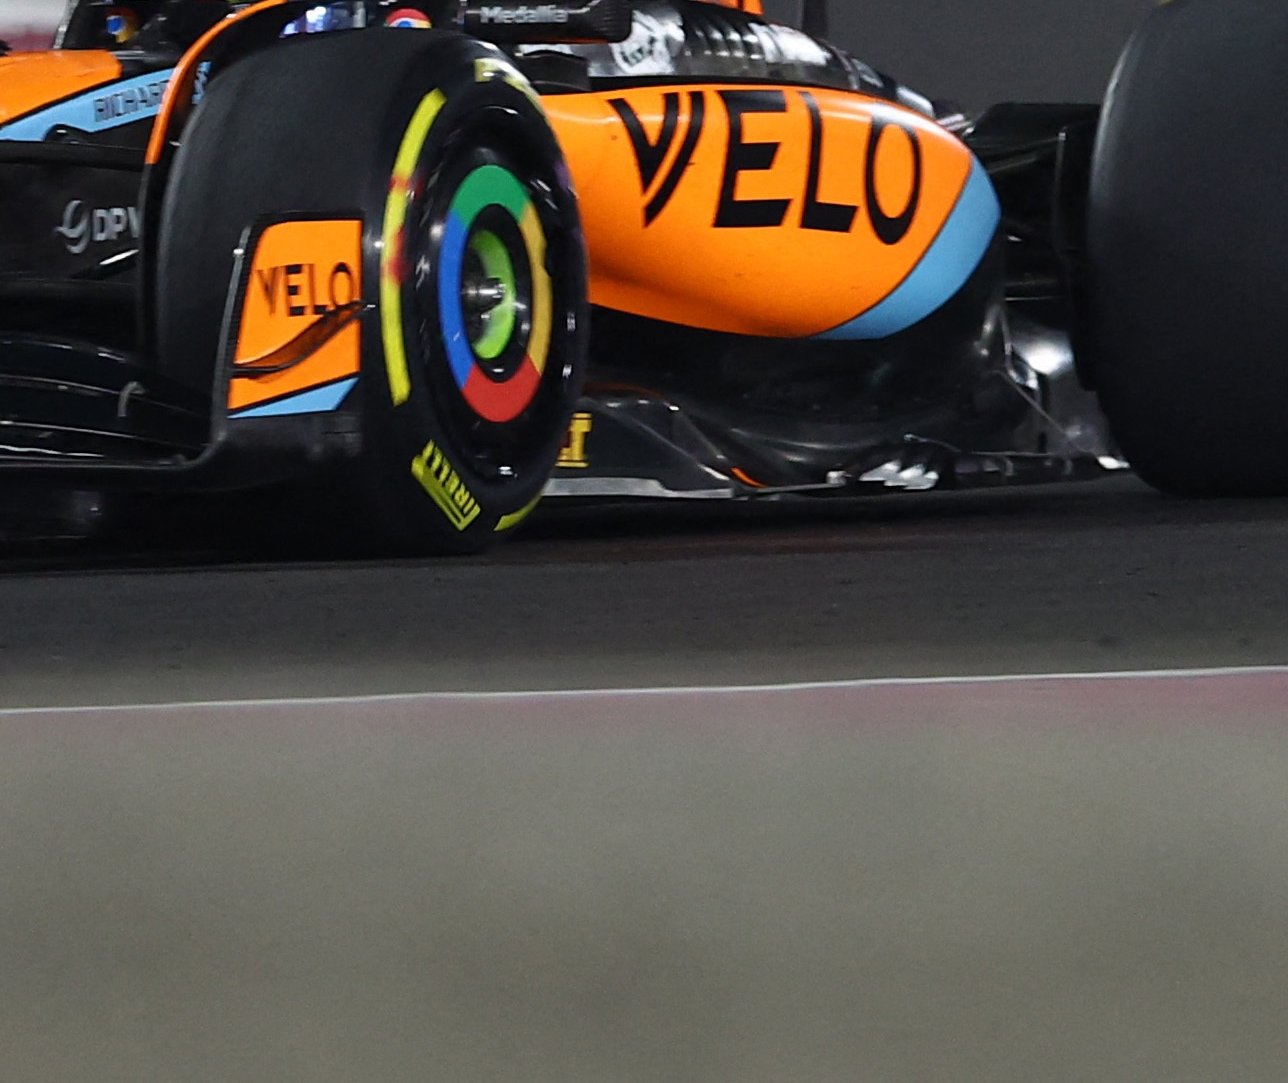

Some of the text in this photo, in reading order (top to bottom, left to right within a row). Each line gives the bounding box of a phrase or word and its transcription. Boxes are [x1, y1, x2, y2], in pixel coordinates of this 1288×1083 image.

[480, 4, 569, 23] Medallia
[606, 89, 922, 245] VELO
[256, 262, 354, 316] VELO
[412, 439, 481, 531] PIRELLI
